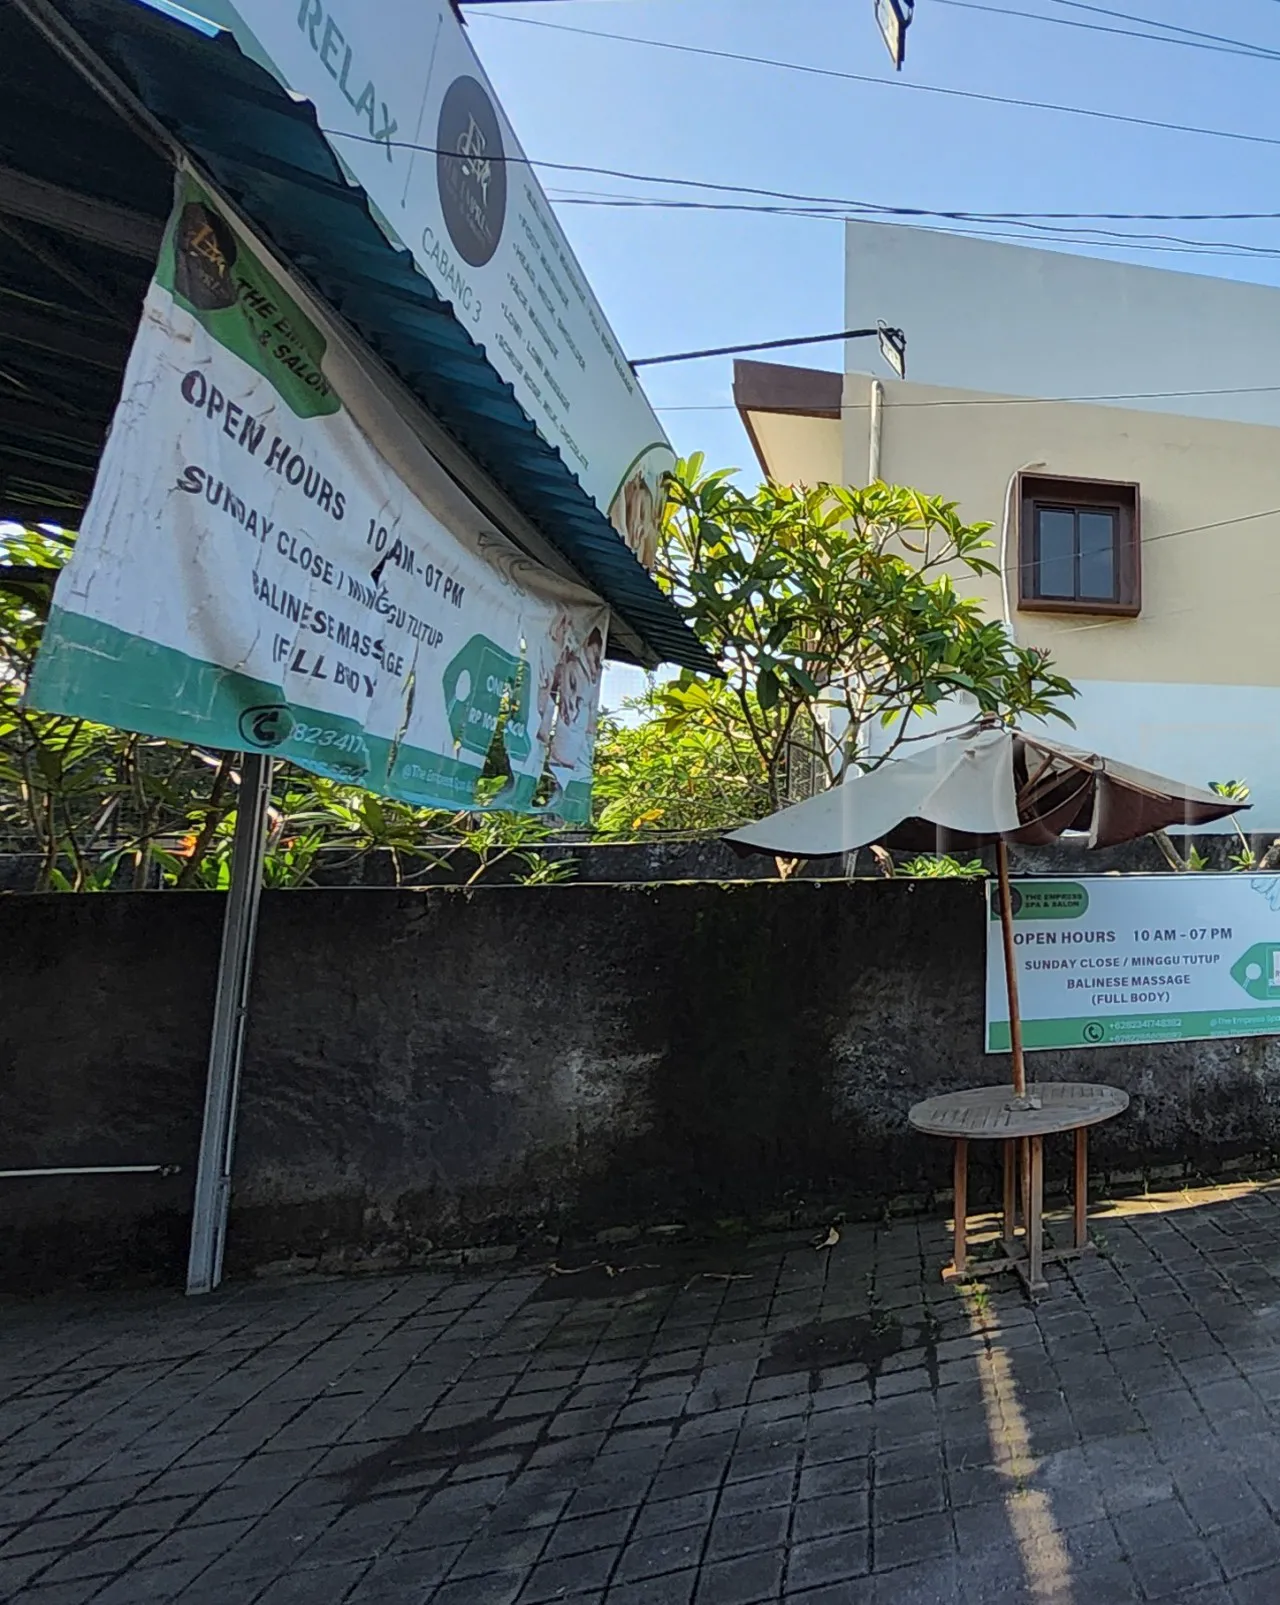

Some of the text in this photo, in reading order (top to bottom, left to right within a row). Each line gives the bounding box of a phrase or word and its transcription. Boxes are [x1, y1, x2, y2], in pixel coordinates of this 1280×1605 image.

[298, 0, 398, 163] RELAX
[422, 227, 482, 323] CABANG 3
[237, 277, 277, 319] THE
[259, 329, 272, 348] &
[273, 344, 330, 397] SALON
[181, 370, 266, 456] OPEN
[264, 436, 346, 521] HOURS
[366, 519, 388, 552] 10
[425, 564, 443, 593] 07
[443, 576, 465, 609] PM
[178, 465, 274, 543] SUNDAY
[276, 531, 334, 585] CLOSE
[407, 615, 444, 649] TUTUP
[1044, 893, 1083, 901] EMPRESS
[1013, 931, 1057, 945] OPEN
[1061, 930, 1116, 944] HOURS
[1133, 930, 1150, 942] 10
[1153, 929, 1176, 941] AM
[1189, 928, 1206, 940] 07
[1211, 927, 1233, 940] PM
[1024, 959, 1077, 971] SUNDAY
[1080, 957, 1120, 968] CLOSE
[1131, 955, 1180, 967] MINGGU
[1181, 954, 1220, 965] TUTUP
[1067, 974, 1191, 989] BALINESE MASSAGE
[1091, 991, 1170, 1006] (FULL BODY)
